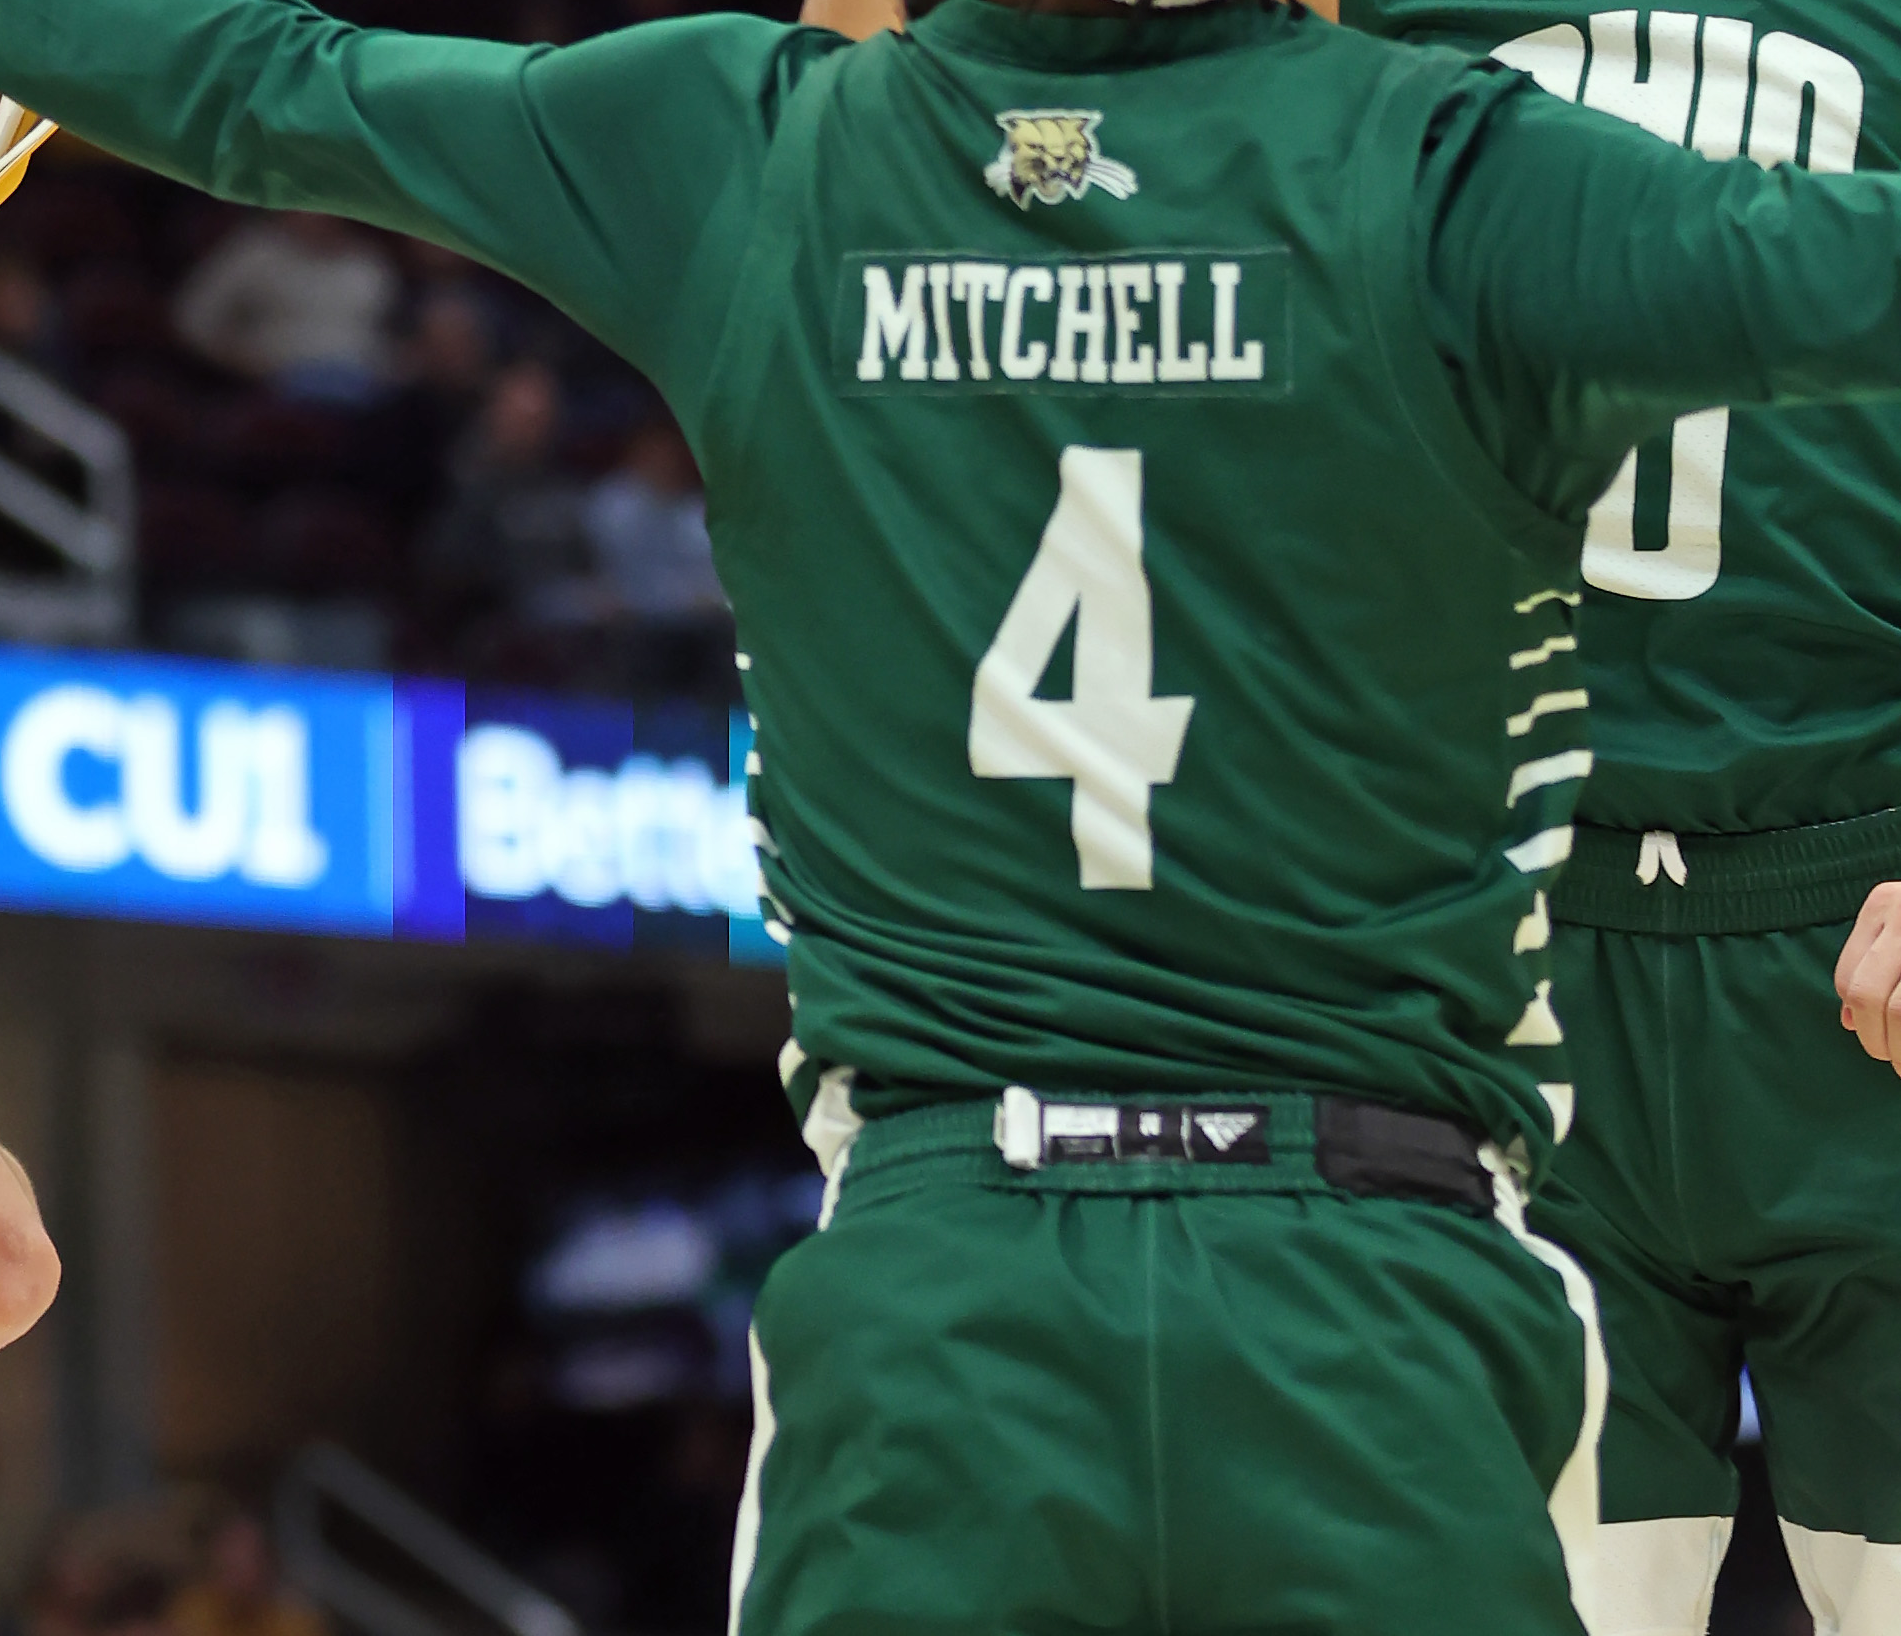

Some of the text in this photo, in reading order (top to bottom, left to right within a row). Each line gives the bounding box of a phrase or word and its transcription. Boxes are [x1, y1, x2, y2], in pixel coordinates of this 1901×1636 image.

[856, 261, 1264, 382] MITCHELL
[967, 443, 1197, 891] 4
[0, 684, 761, 916] CU1 Bette
